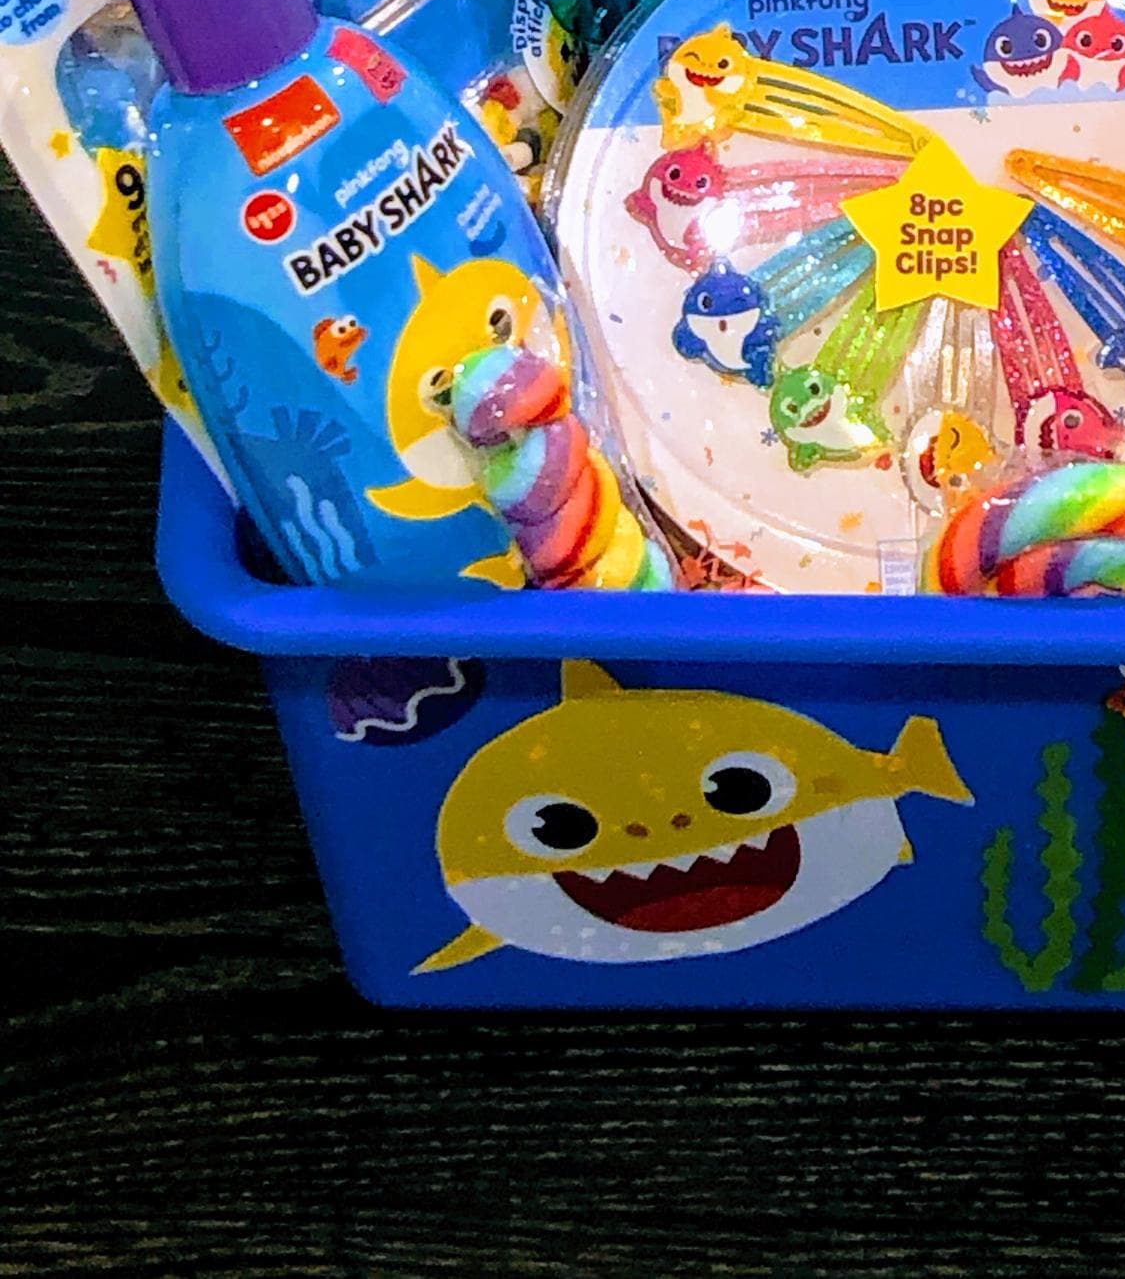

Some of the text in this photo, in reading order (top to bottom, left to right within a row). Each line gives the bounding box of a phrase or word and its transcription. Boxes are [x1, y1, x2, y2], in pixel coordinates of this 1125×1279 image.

[21, 3, 61, 38] from
[289, 209, 381, 290] BABY
[379, 124, 466, 231] SHARK
[909, 193, 963, 223] 8pc
[900, 222, 974, 252] Snap
[895, 250, 978, 281] Clips!
